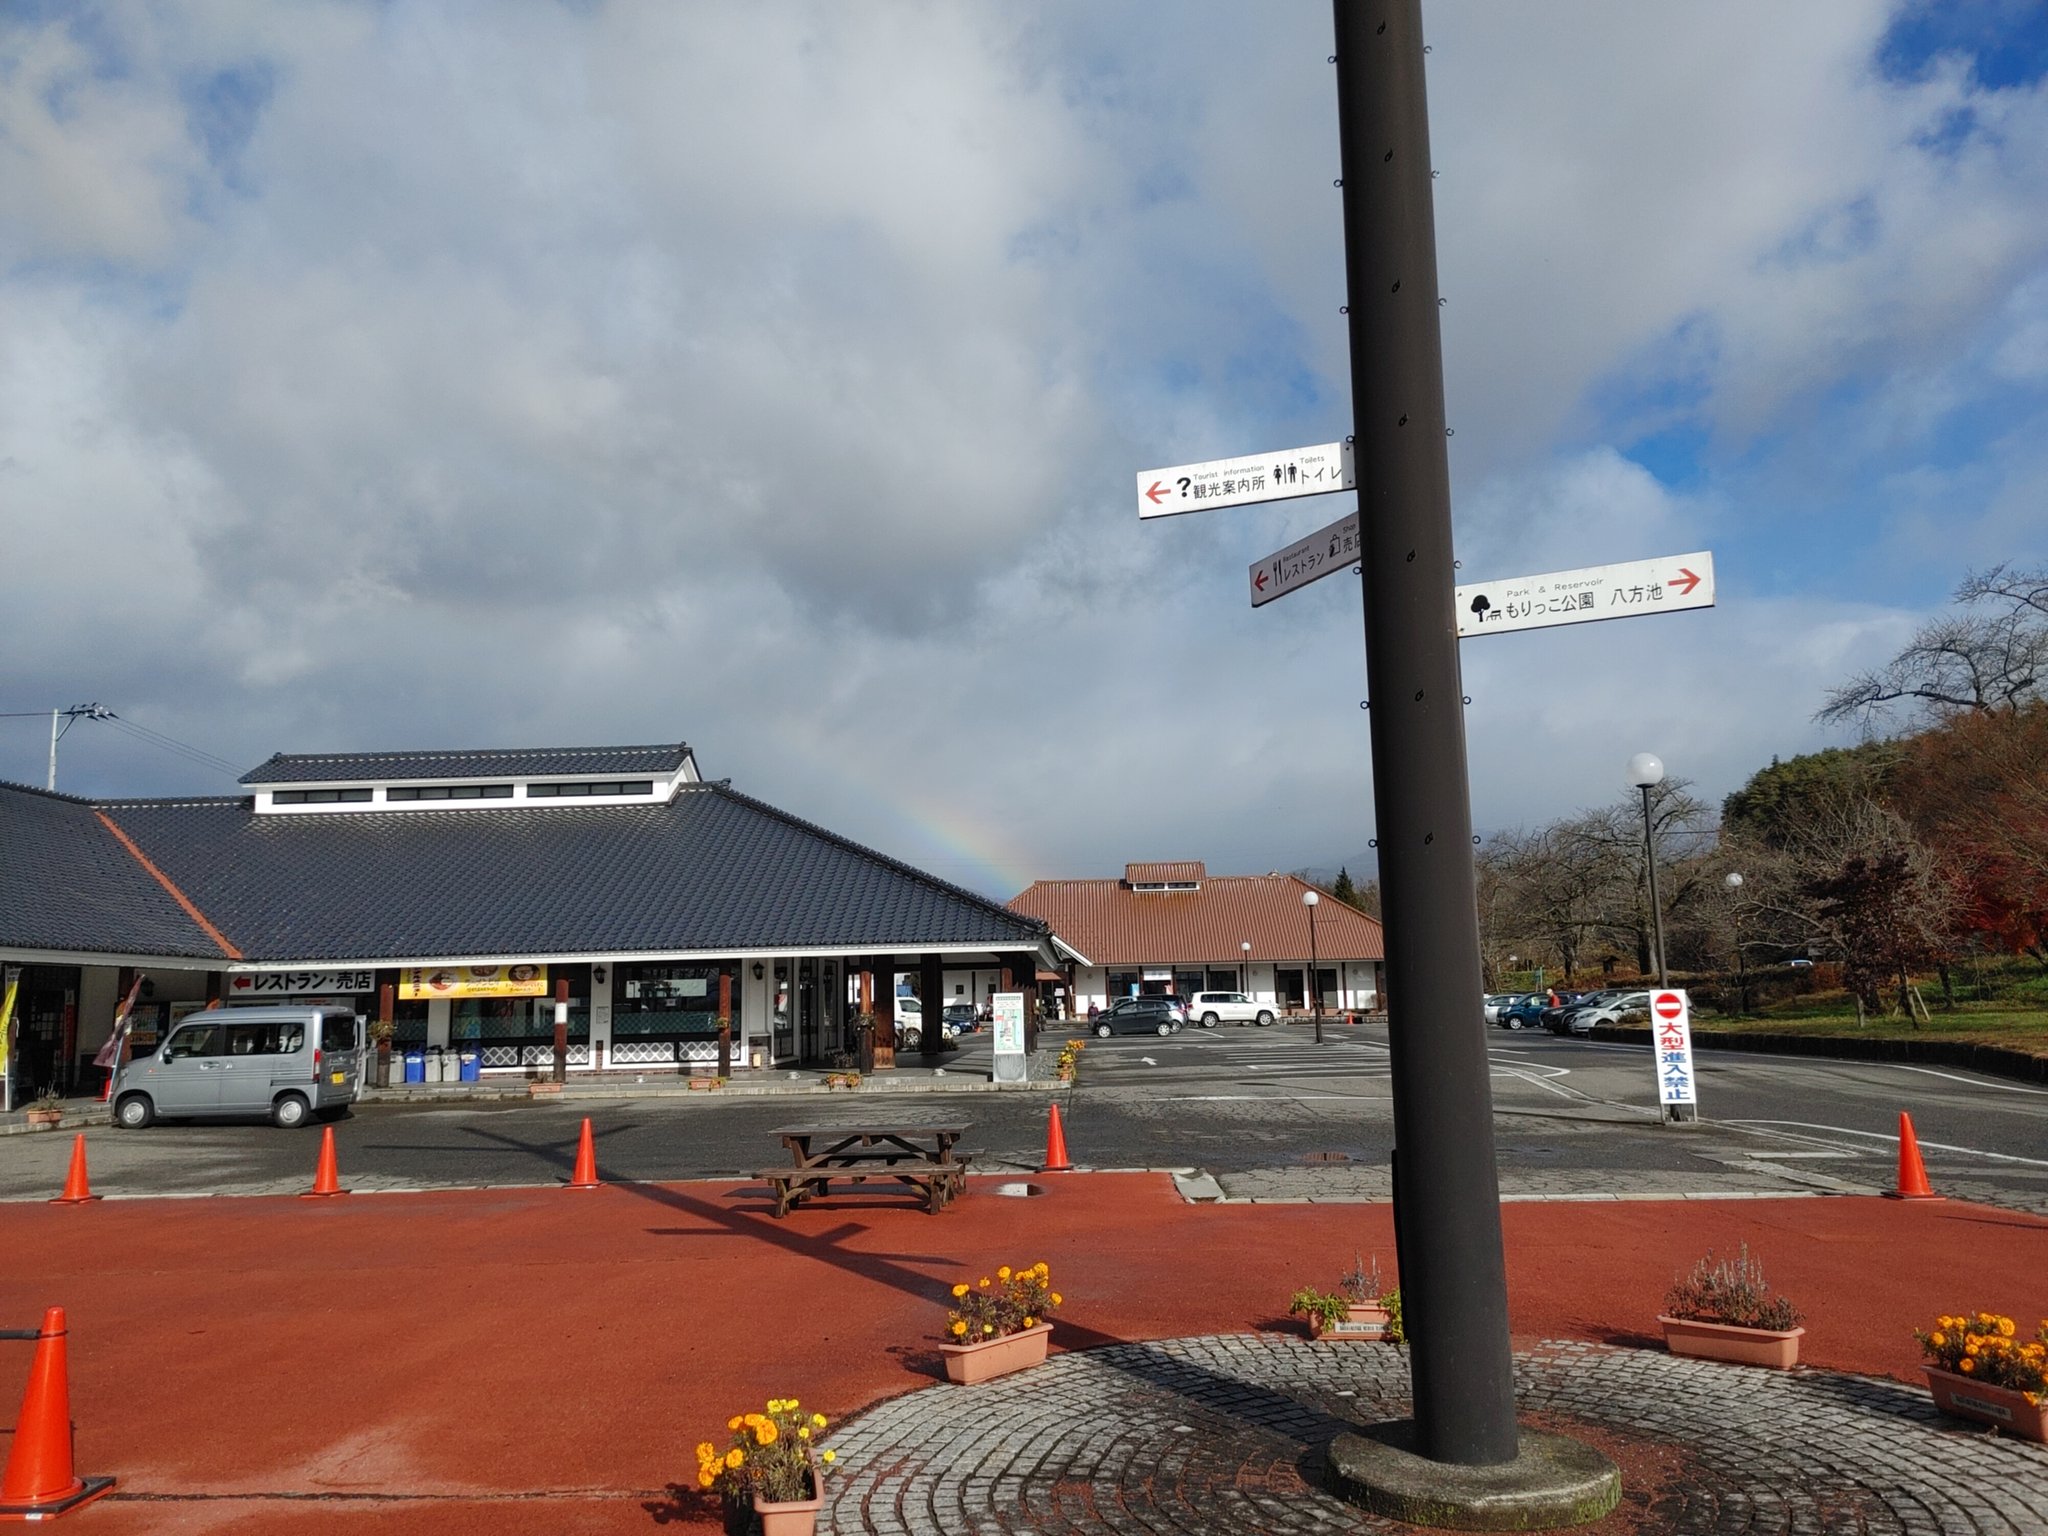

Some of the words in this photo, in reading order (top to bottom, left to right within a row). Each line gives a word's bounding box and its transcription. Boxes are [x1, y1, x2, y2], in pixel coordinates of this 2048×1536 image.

[1300, 455, 1325, 465] Toilets
[1193, 471, 1218, 481] Tourist
[1223, 465, 1265, 477] information
[1301, 466, 1342, 485] トイレ
[1193, 475, 1265, 500] 観光案内所
[1283, 553, 1325, 582] レストラン
[1506, 589, 1530, 598] Park
[1554, 578, 1604, 591] Reservoir
[1506, 592, 1594, 619] もりっこ公園
[1610, 583, 1664, 606] 八方池
[253, 971, 372, 991] レストラン・売店
[1659, 1022, 1690, 1100] 大型進入禁止
